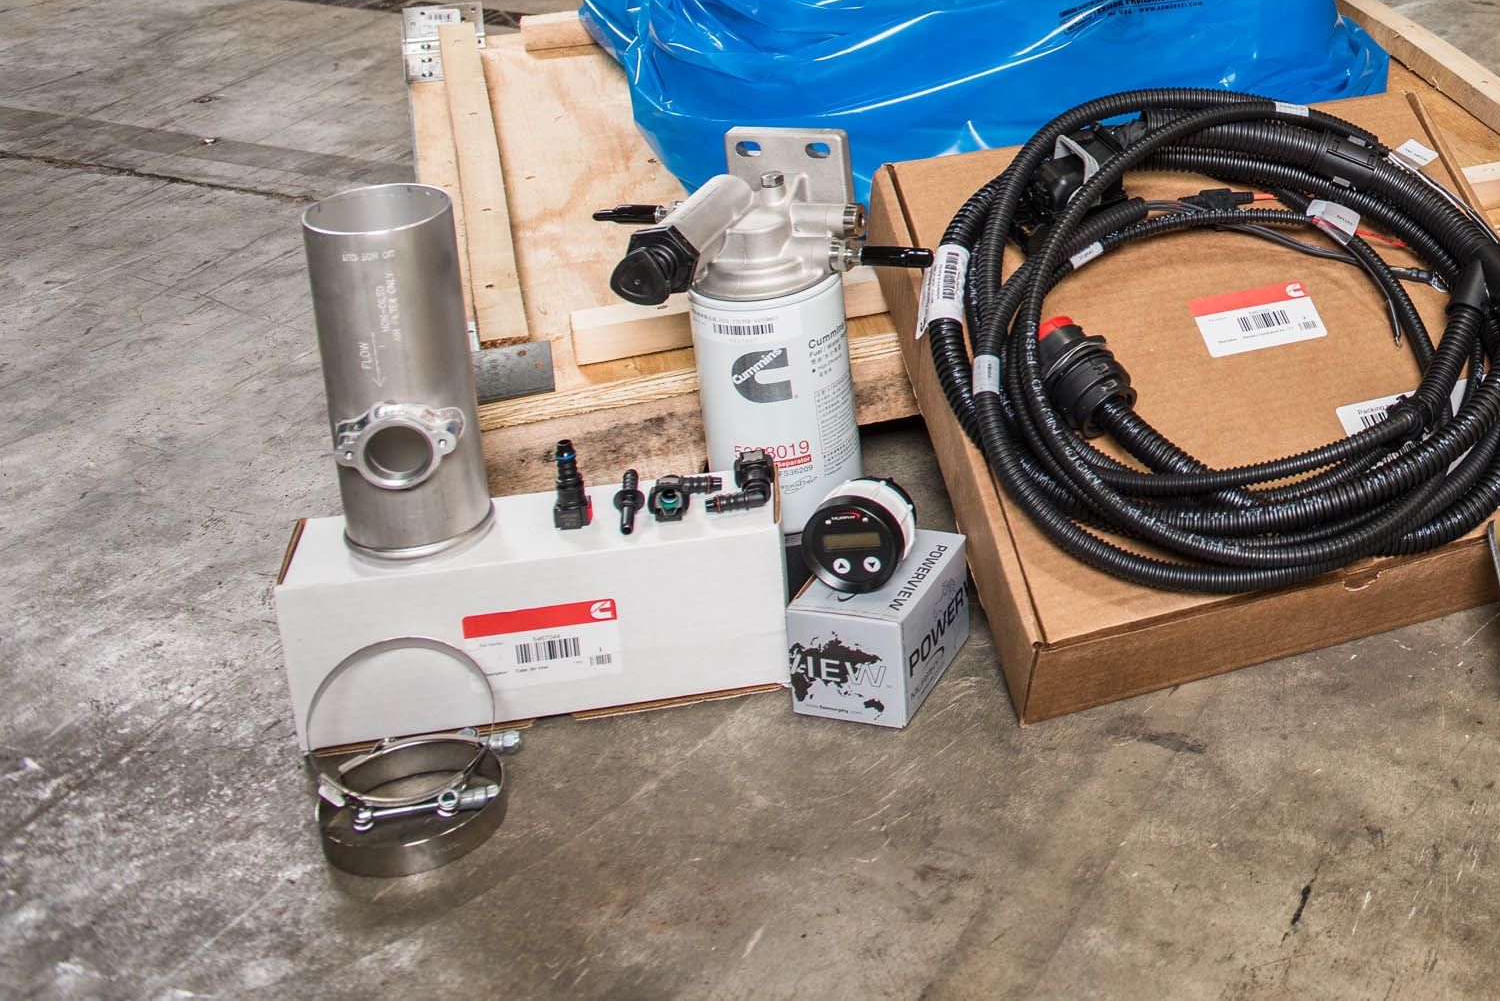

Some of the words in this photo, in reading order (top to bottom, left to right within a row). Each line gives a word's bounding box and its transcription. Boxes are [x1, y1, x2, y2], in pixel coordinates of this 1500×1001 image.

[808, 321, 847, 350] Cummins
[358, 342, 372, 370] FLOW
[809, 346, 823, 358] Fuel
[732, 348, 783, 386] Cummins
[1357, 405, 1386, 416] Packing
[888, 544, 948, 612] POWERVIEW
